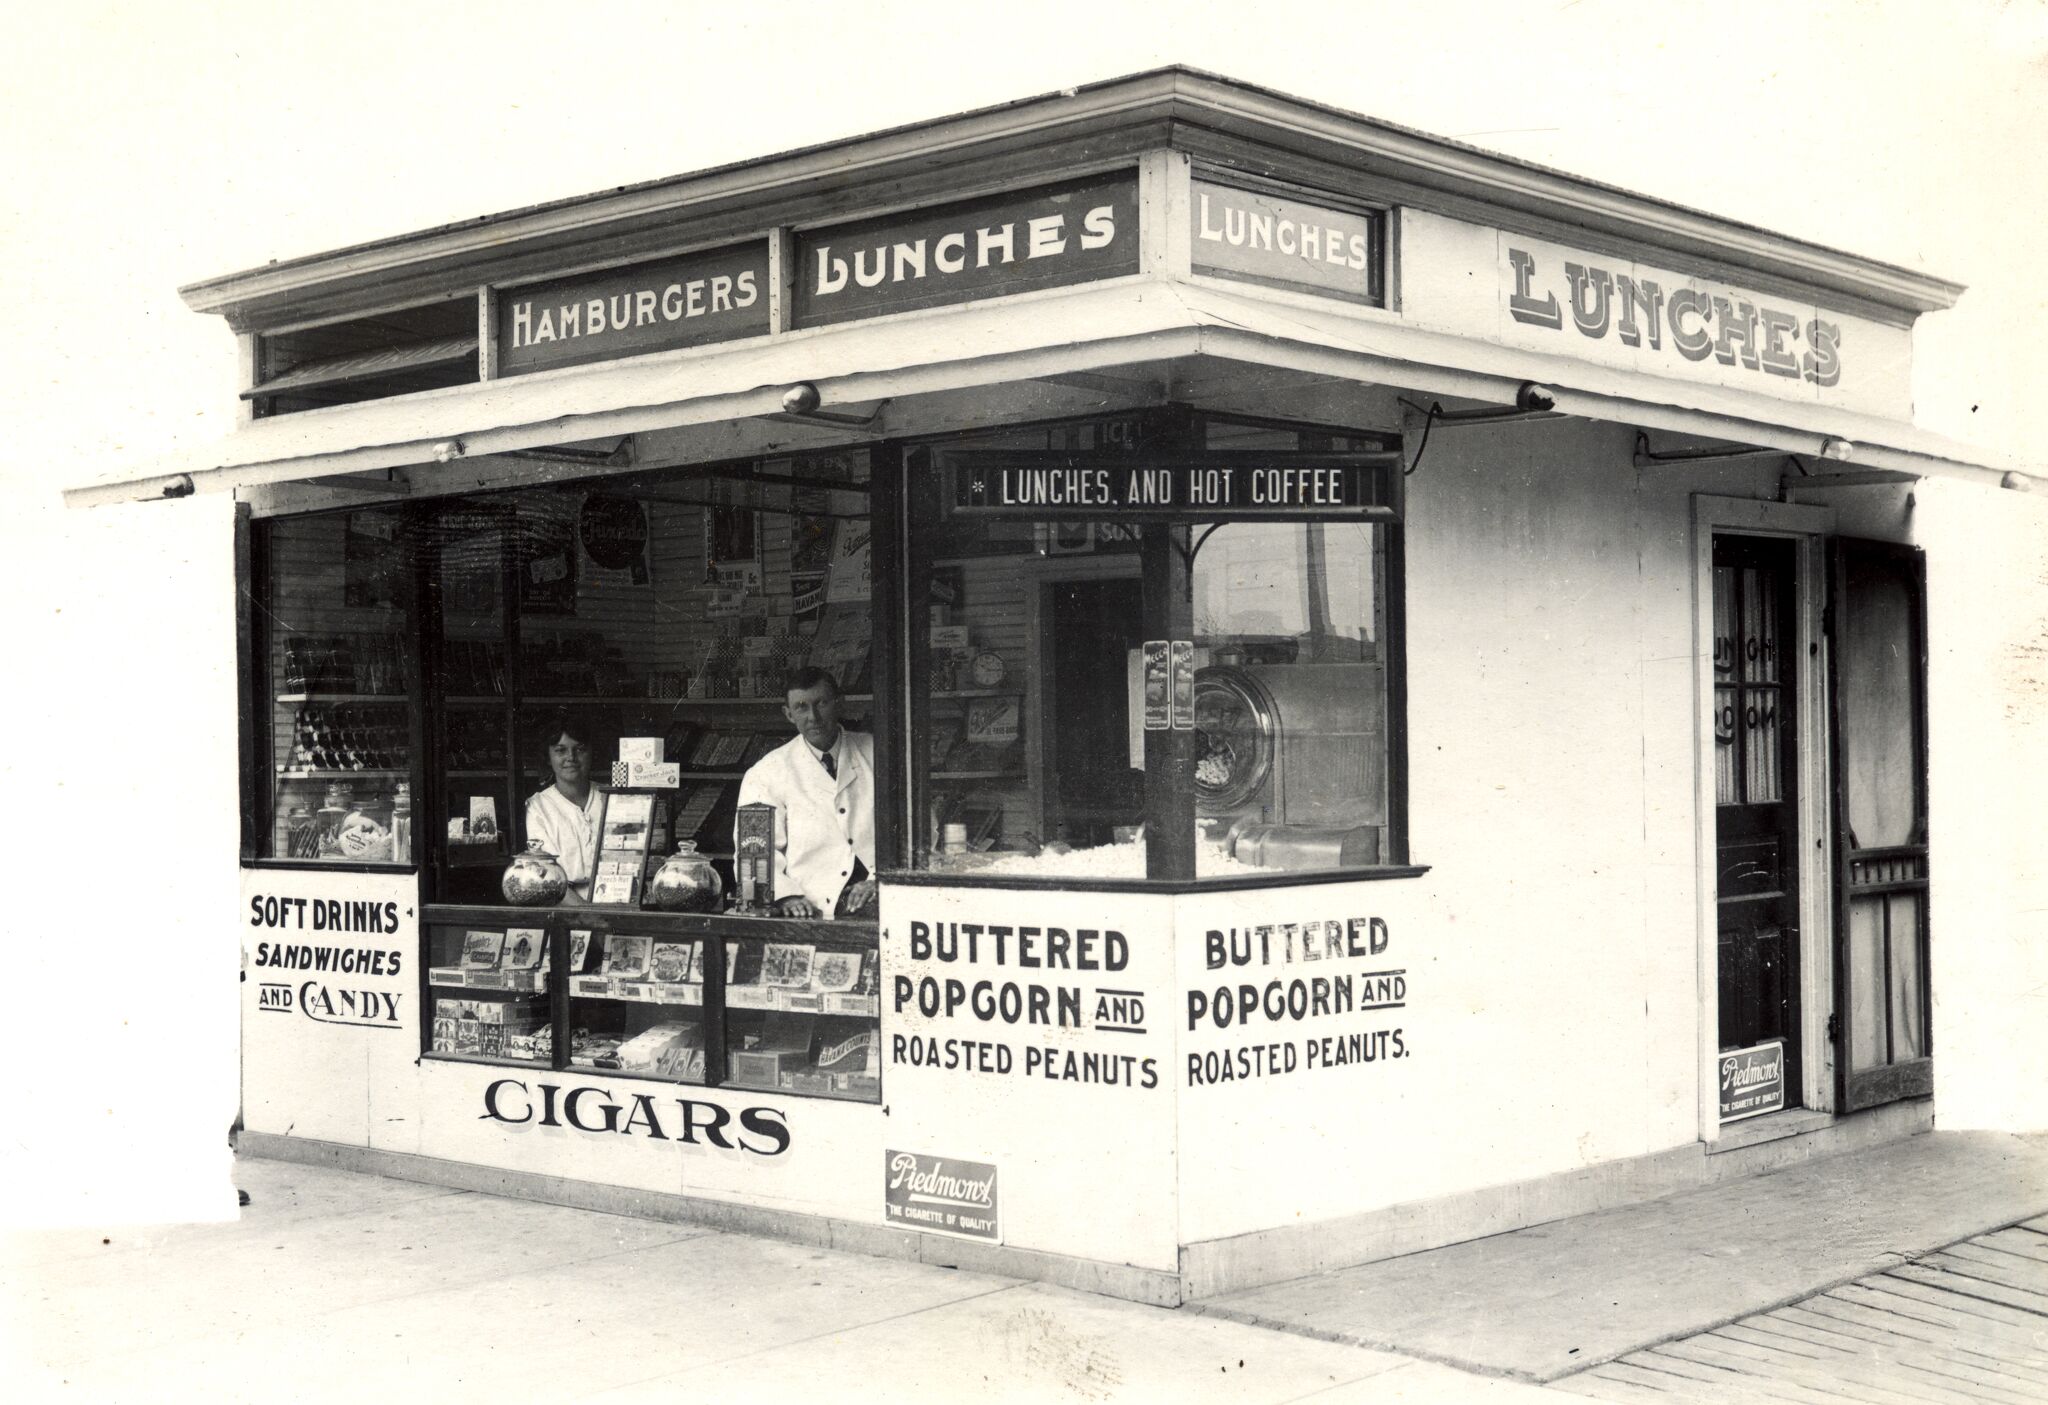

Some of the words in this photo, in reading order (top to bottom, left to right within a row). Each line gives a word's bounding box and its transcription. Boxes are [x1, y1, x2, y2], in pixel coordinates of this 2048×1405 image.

[815, 205, 1115, 296] LUNCHES
[1199, 194, 1368, 271] LUNCHES
[512, 269, 757, 348] HAMBURGERS
[1509, 248, 1841, 388] LUNCHES
[1128, 469, 1172, 504] AND
[1190, 469, 1232, 504] HOT
[1251, 469, 1342, 504] COFFEE
[251, 895, 307, 929] SOFT
[313, 899, 399, 934] DRINKS
[911, 920, 1130, 971] BUTTERED
[1206, 917, 1389, 970] BUTTERED
[259, 988, 293, 1007] AND
[1095, 995, 1145, 1025] AND
[1361, 975, 1406, 1003] AND
[893, 1034, 1013, 1075] ROASTED
[1026, 1046, 1159, 1089] PEANUTS
[1188, 1042, 1297, 1087] ROASTED
[1306, 1028, 1410, 1069] PEANUTS.
[1721, 1053, 1780, 1091] Piedmont
[485, 1079, 792, 1156] CIGARS
[1731, 1097, 1754, 1111] CIGARETTE
[1755, 1095, 1761, 1105] OF
[889, 1152, 995, 1205] Piedmont
[905, 1206, 943, 1224] CIGARETTE
[946, 1213, 957, 1225] OF
